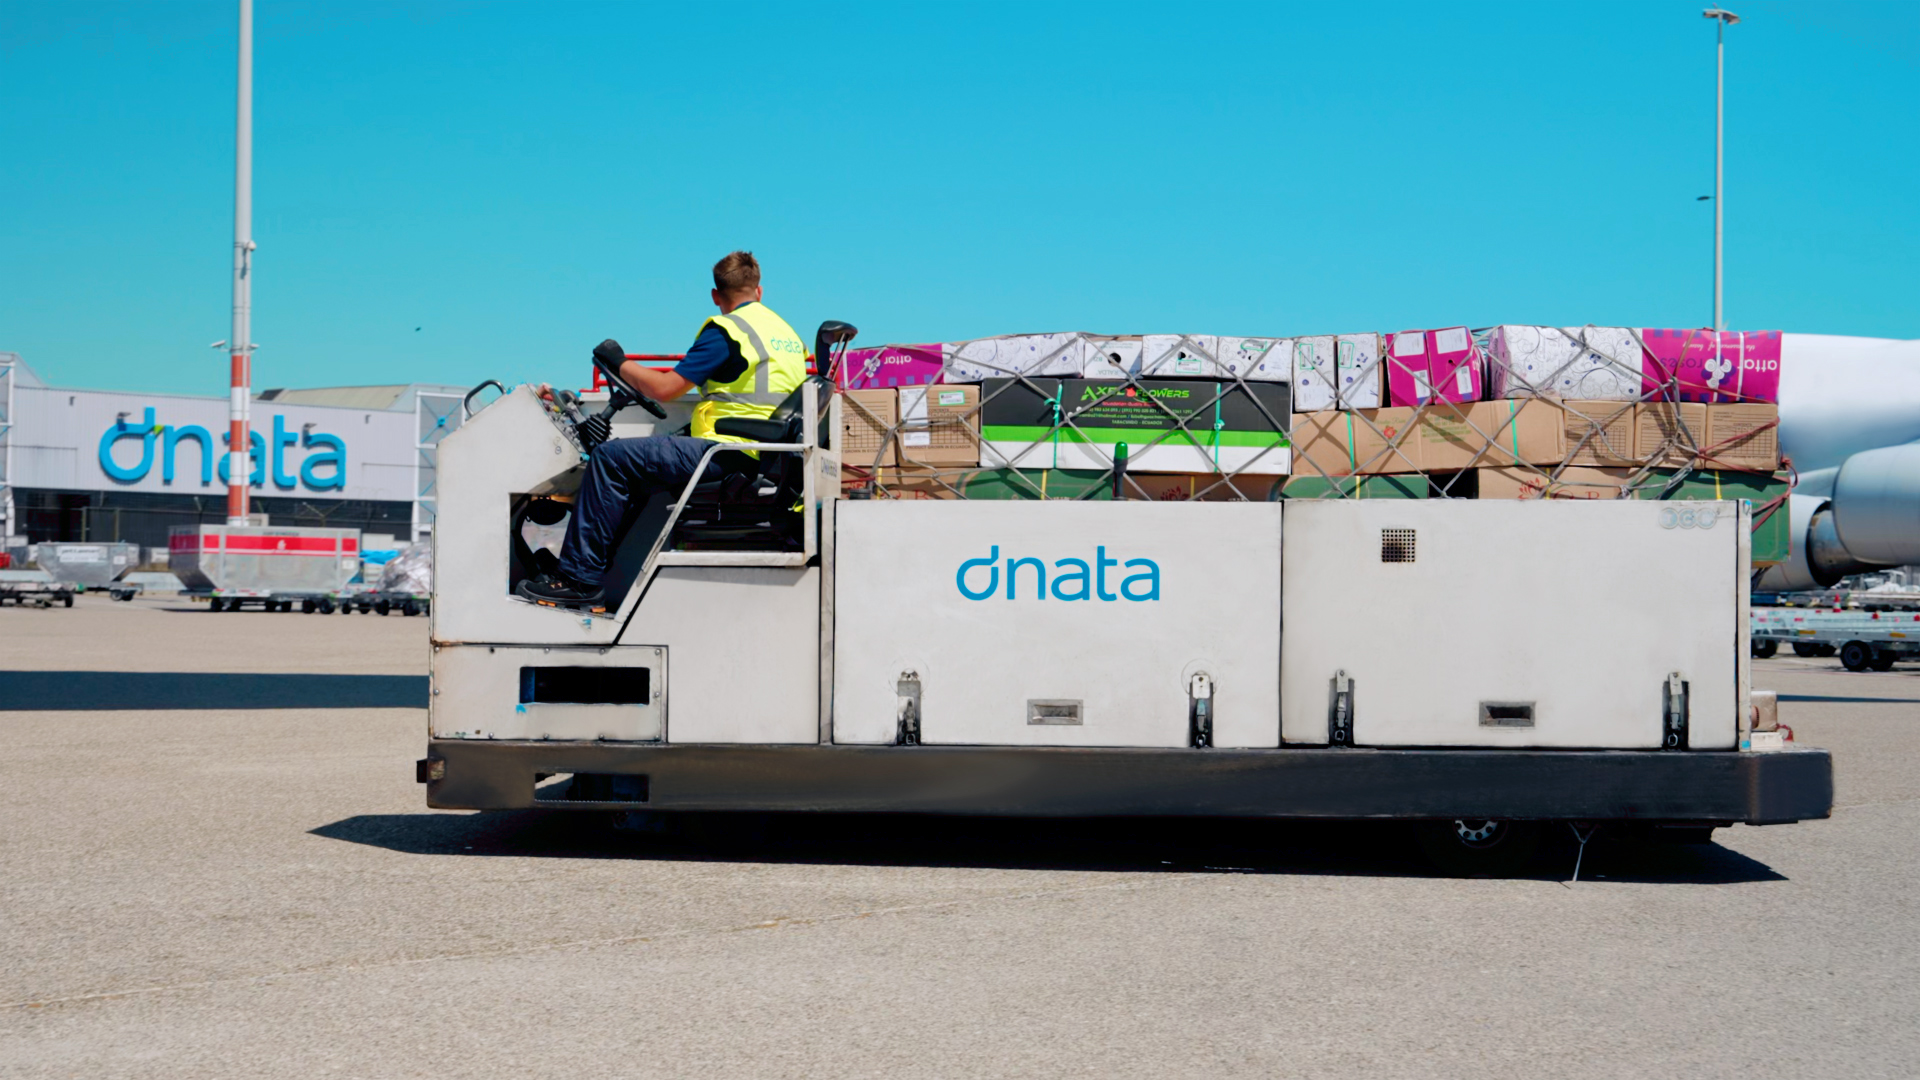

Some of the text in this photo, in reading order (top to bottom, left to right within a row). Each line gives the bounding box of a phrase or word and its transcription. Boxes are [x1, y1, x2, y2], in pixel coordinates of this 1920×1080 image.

[883, 354, 912, 365] attar
[99, 406, 347, 488] dnata
[956, 545, 1160, 602] dnata
